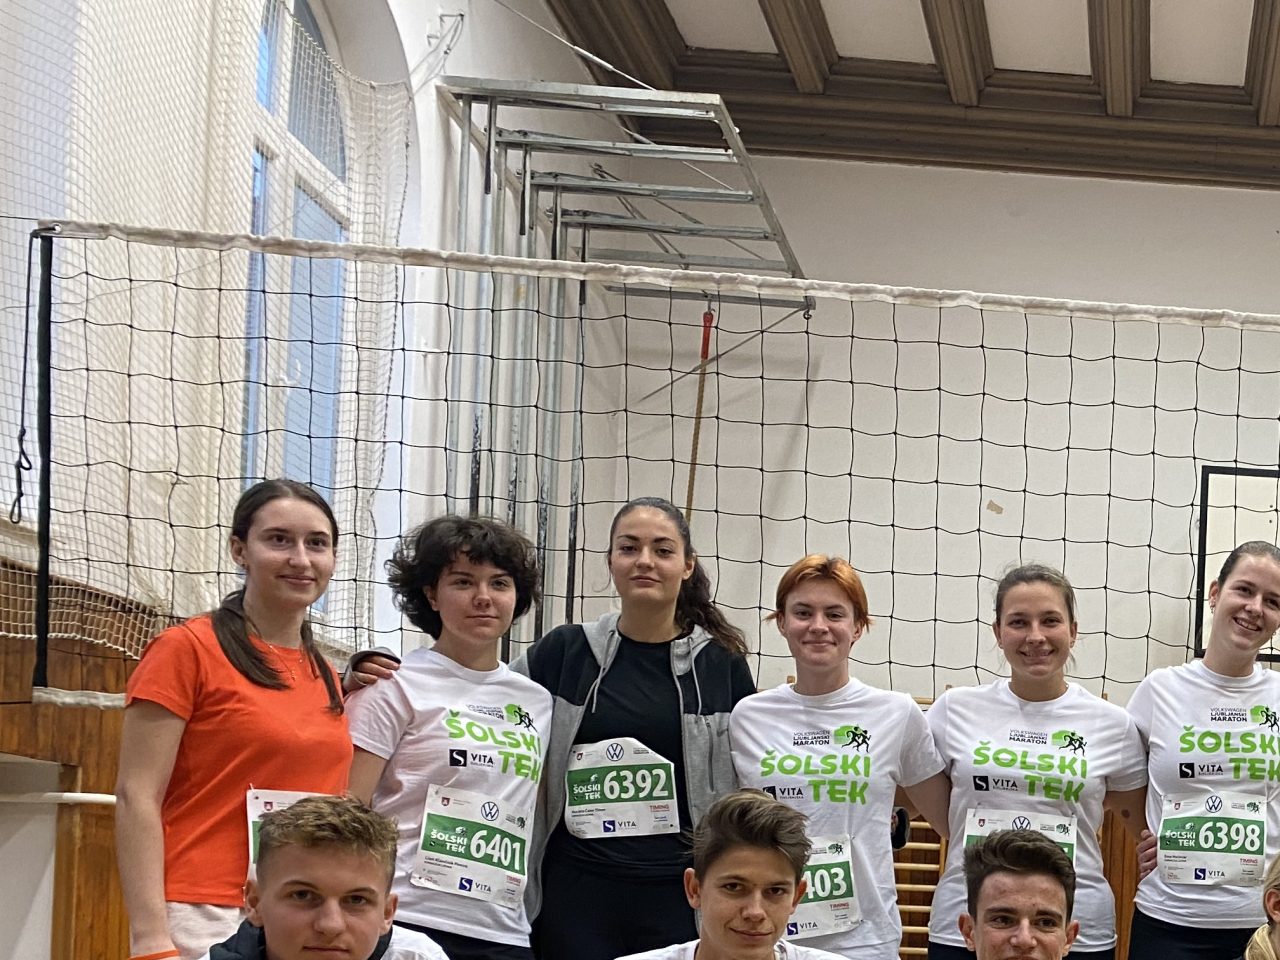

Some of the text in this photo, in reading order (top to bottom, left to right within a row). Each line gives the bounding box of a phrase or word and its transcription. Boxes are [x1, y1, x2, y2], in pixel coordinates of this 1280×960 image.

[1009, 737, 1047, 745] MARATON
[471, 753, 494, 764] VITA
[760, 749, 870, 778] ŠOLSKI
[973, 740, 1088, 779] ŠOLSKI
[498, 750, 540, 784] TEK
[1198, 764, 1223, 773] VITA
[573, 784, 600, 793] ŠOLSKI
[604, 769, 668, 799] 6392
[992, 778, 1018, 788] VITA
[1024, 775, 1085, 803] TEK
[585, 792, 600, 800] TEK
[779, 787, 803, 796] VITA
[808, 779, 869, 805] TEK
[431, 829, 467, 845] ŠOLSKI
[1199, 821, 1260, 851] 6398
[445, 842, 466, 853] TEK
[1178, 839, 1195, 847] TEK
[470, 830, 521, 870] 6401
[475, 883, 491, 892] VITA
[803, 867, 847, 899] 403
